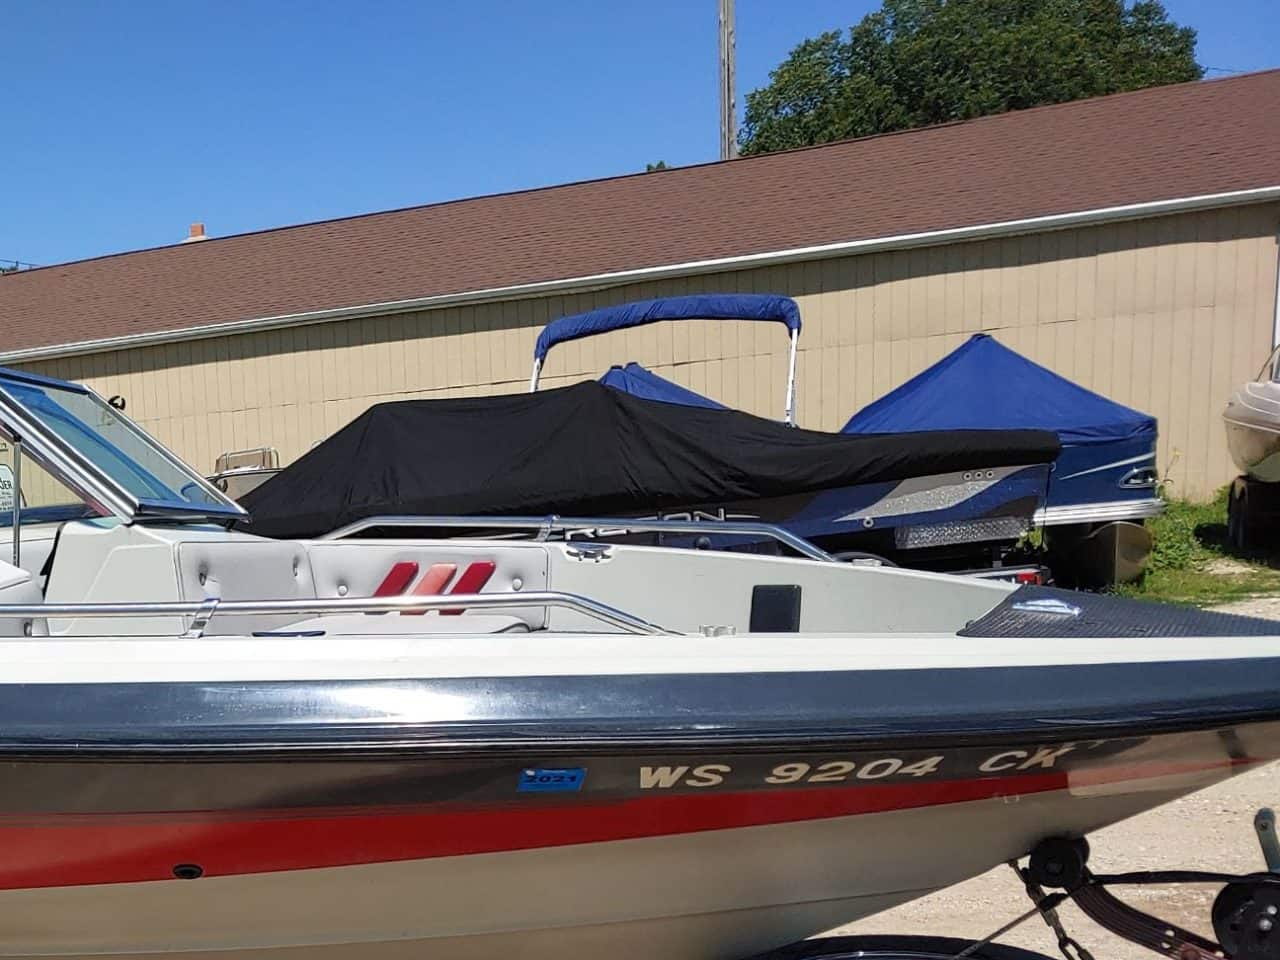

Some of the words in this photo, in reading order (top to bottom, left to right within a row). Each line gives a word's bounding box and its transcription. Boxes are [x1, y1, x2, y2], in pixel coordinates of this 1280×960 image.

[639, 764, 732, 789] WS
[764, 755, 944, 784] 9204
[978, 745, 1074, 772] CK
